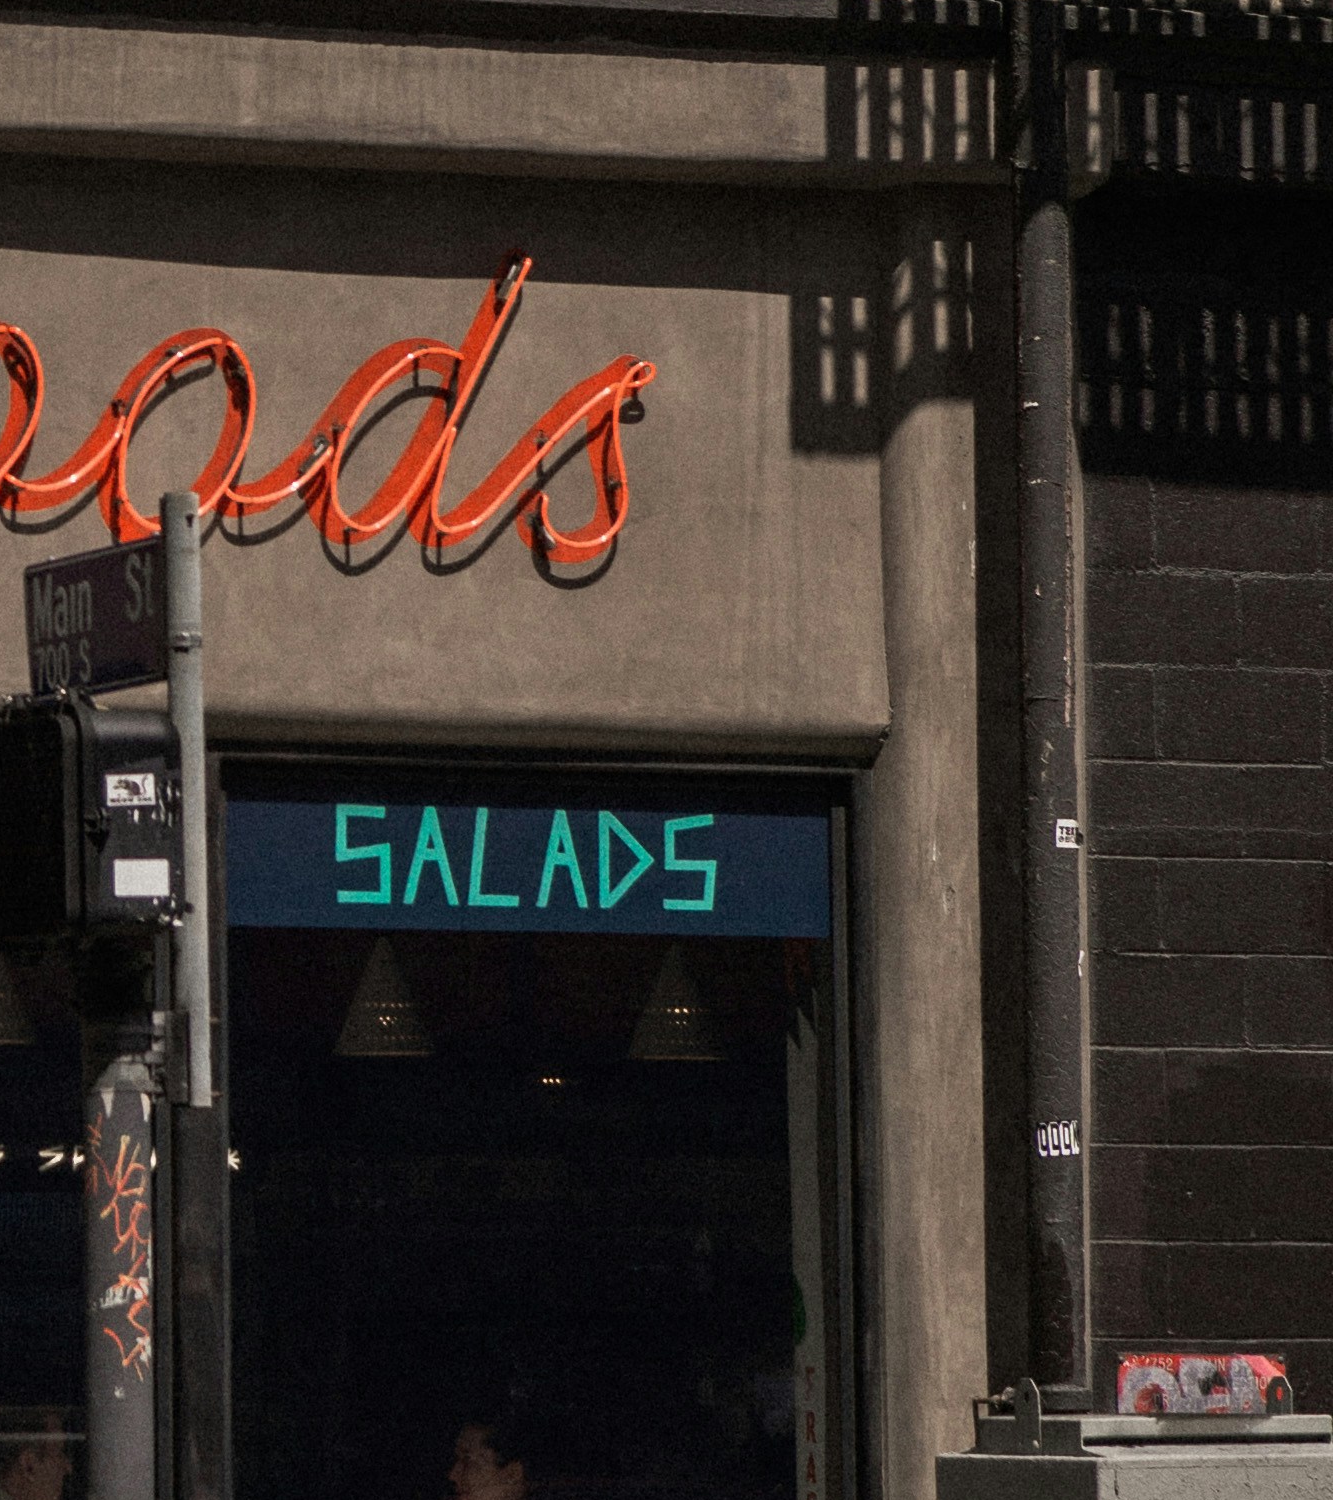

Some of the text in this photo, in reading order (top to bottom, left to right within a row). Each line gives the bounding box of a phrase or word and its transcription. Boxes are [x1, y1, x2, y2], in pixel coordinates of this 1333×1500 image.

[31, 553, 155, 644] Main St
[34, 637, 93, 693] 700 S
[334, 804, 717, 911] SALADS
